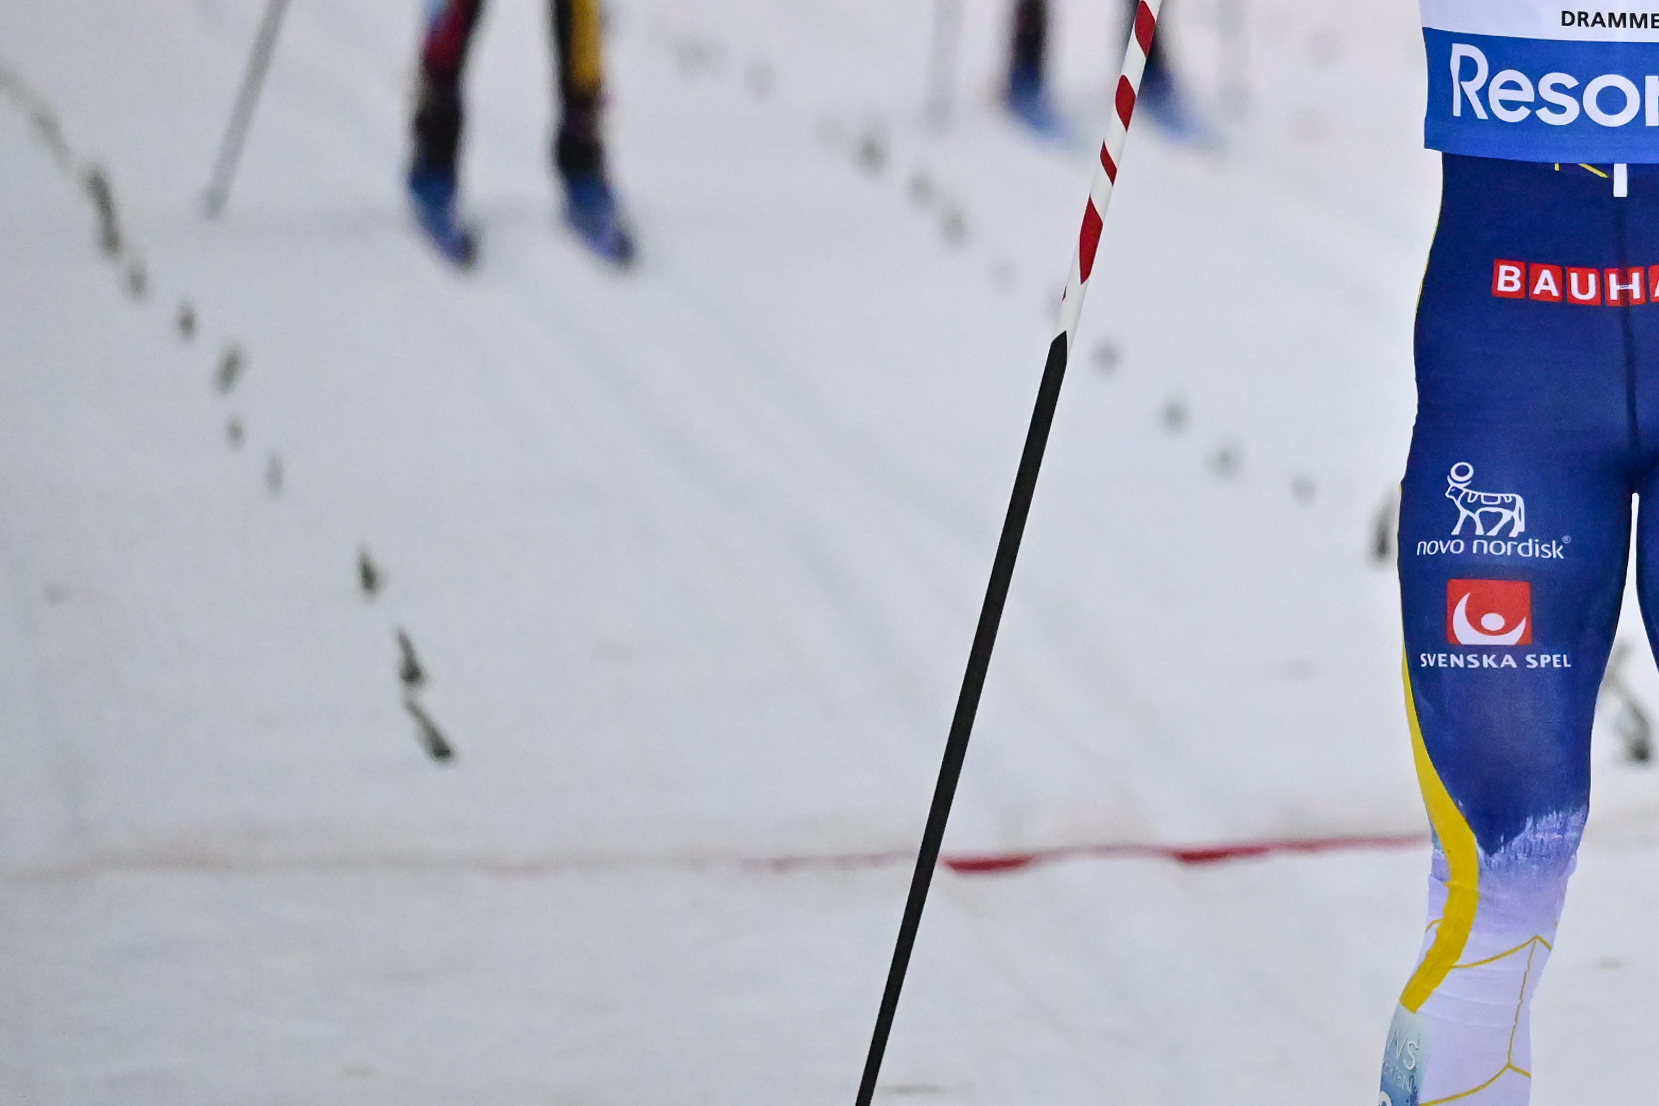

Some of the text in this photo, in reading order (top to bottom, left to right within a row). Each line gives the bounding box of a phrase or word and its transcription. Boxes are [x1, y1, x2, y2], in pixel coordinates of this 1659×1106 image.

[1417, 538, 1564, 559] novo nordisk
[1420, 653, 1571, 669] SVENSKA SPEL
